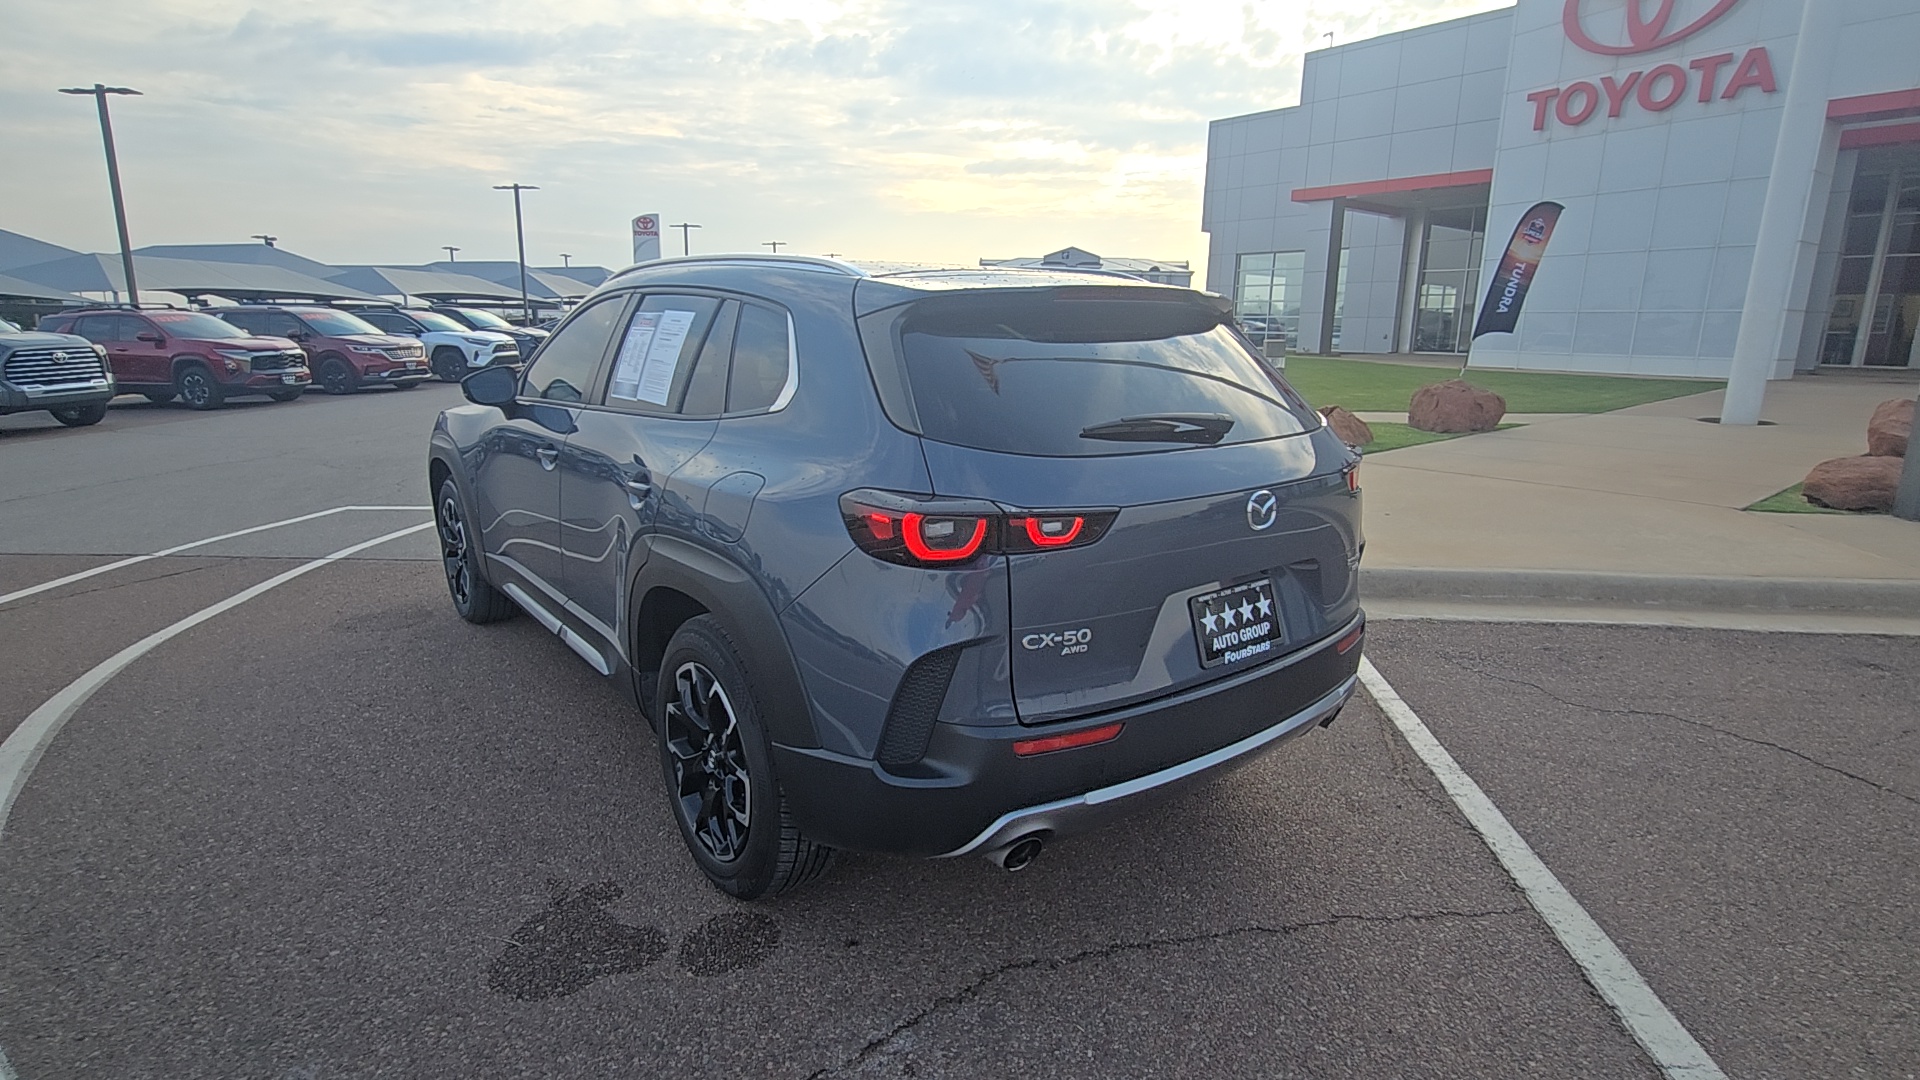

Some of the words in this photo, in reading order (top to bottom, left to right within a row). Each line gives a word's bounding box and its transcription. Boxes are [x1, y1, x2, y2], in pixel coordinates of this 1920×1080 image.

[1527, 46, 1777, 131] TOYOTA
[1496, 262, 1527, 313] TUNDRA
[1021, 628, 1092, 650] CX-50
[1061, 644, 1088, 656] AWD
[1212, 631, 1239, 652] AUTO
[1239, 621, 1271, 642] GROUP
